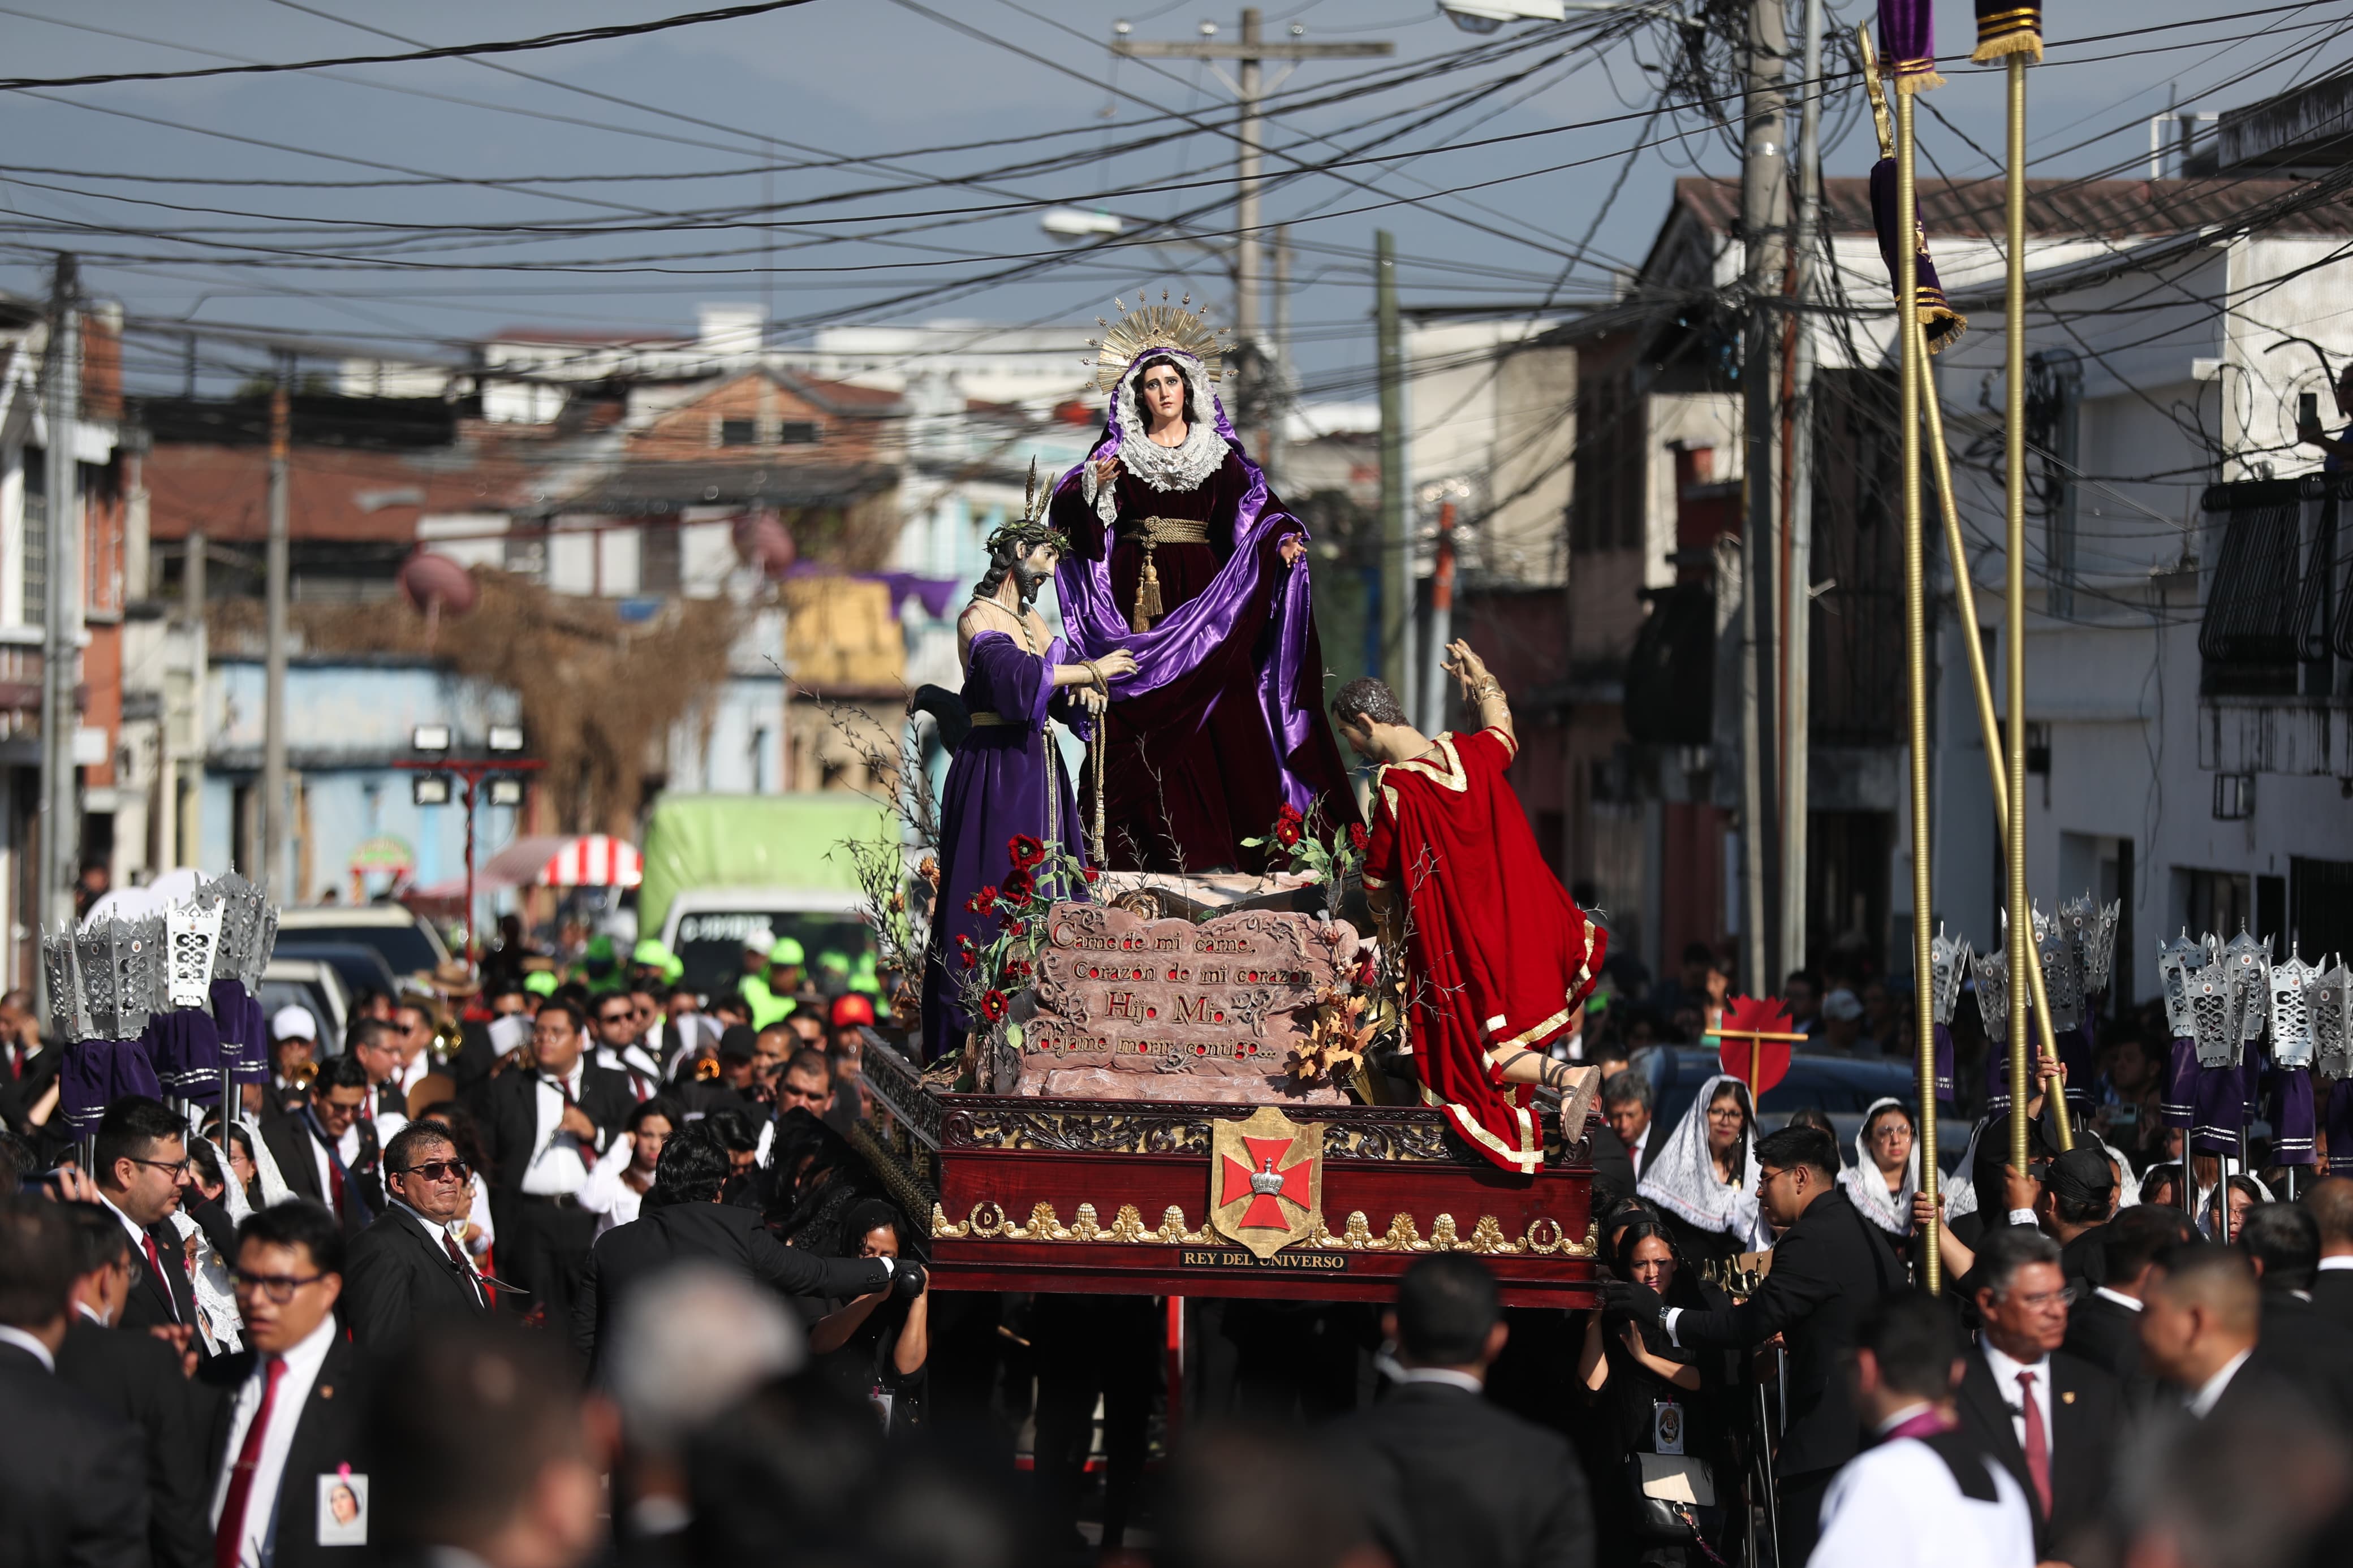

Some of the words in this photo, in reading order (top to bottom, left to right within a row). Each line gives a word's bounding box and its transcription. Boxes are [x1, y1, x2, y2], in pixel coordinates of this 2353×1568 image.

[1052, 921, 1117, 949] Carne
[1122, 932, 1145, 950] de
[1156, 932, 1181, 950] mi
[1195, 939, 1256, 954] carne,
[1074, 962, 1156, 980] Corazón
[1167, 962, 1190, 983] de
[1200, 965, 1226, 983] mi
[1236, 966, 1320, 985] corazón.
[1105, 991, 1157, 1023] Hijo
[1041, 1031, 1107, 1056] déjame
[1120, 1036, 1174, 1054] morir
[1186, 1039, 1276, 1060] contigo...
[984, 1212, 992, 1225] D
[1184, 1252, 1217, 1265] REY
[1222, 1253, 1253, 1266] DEL
